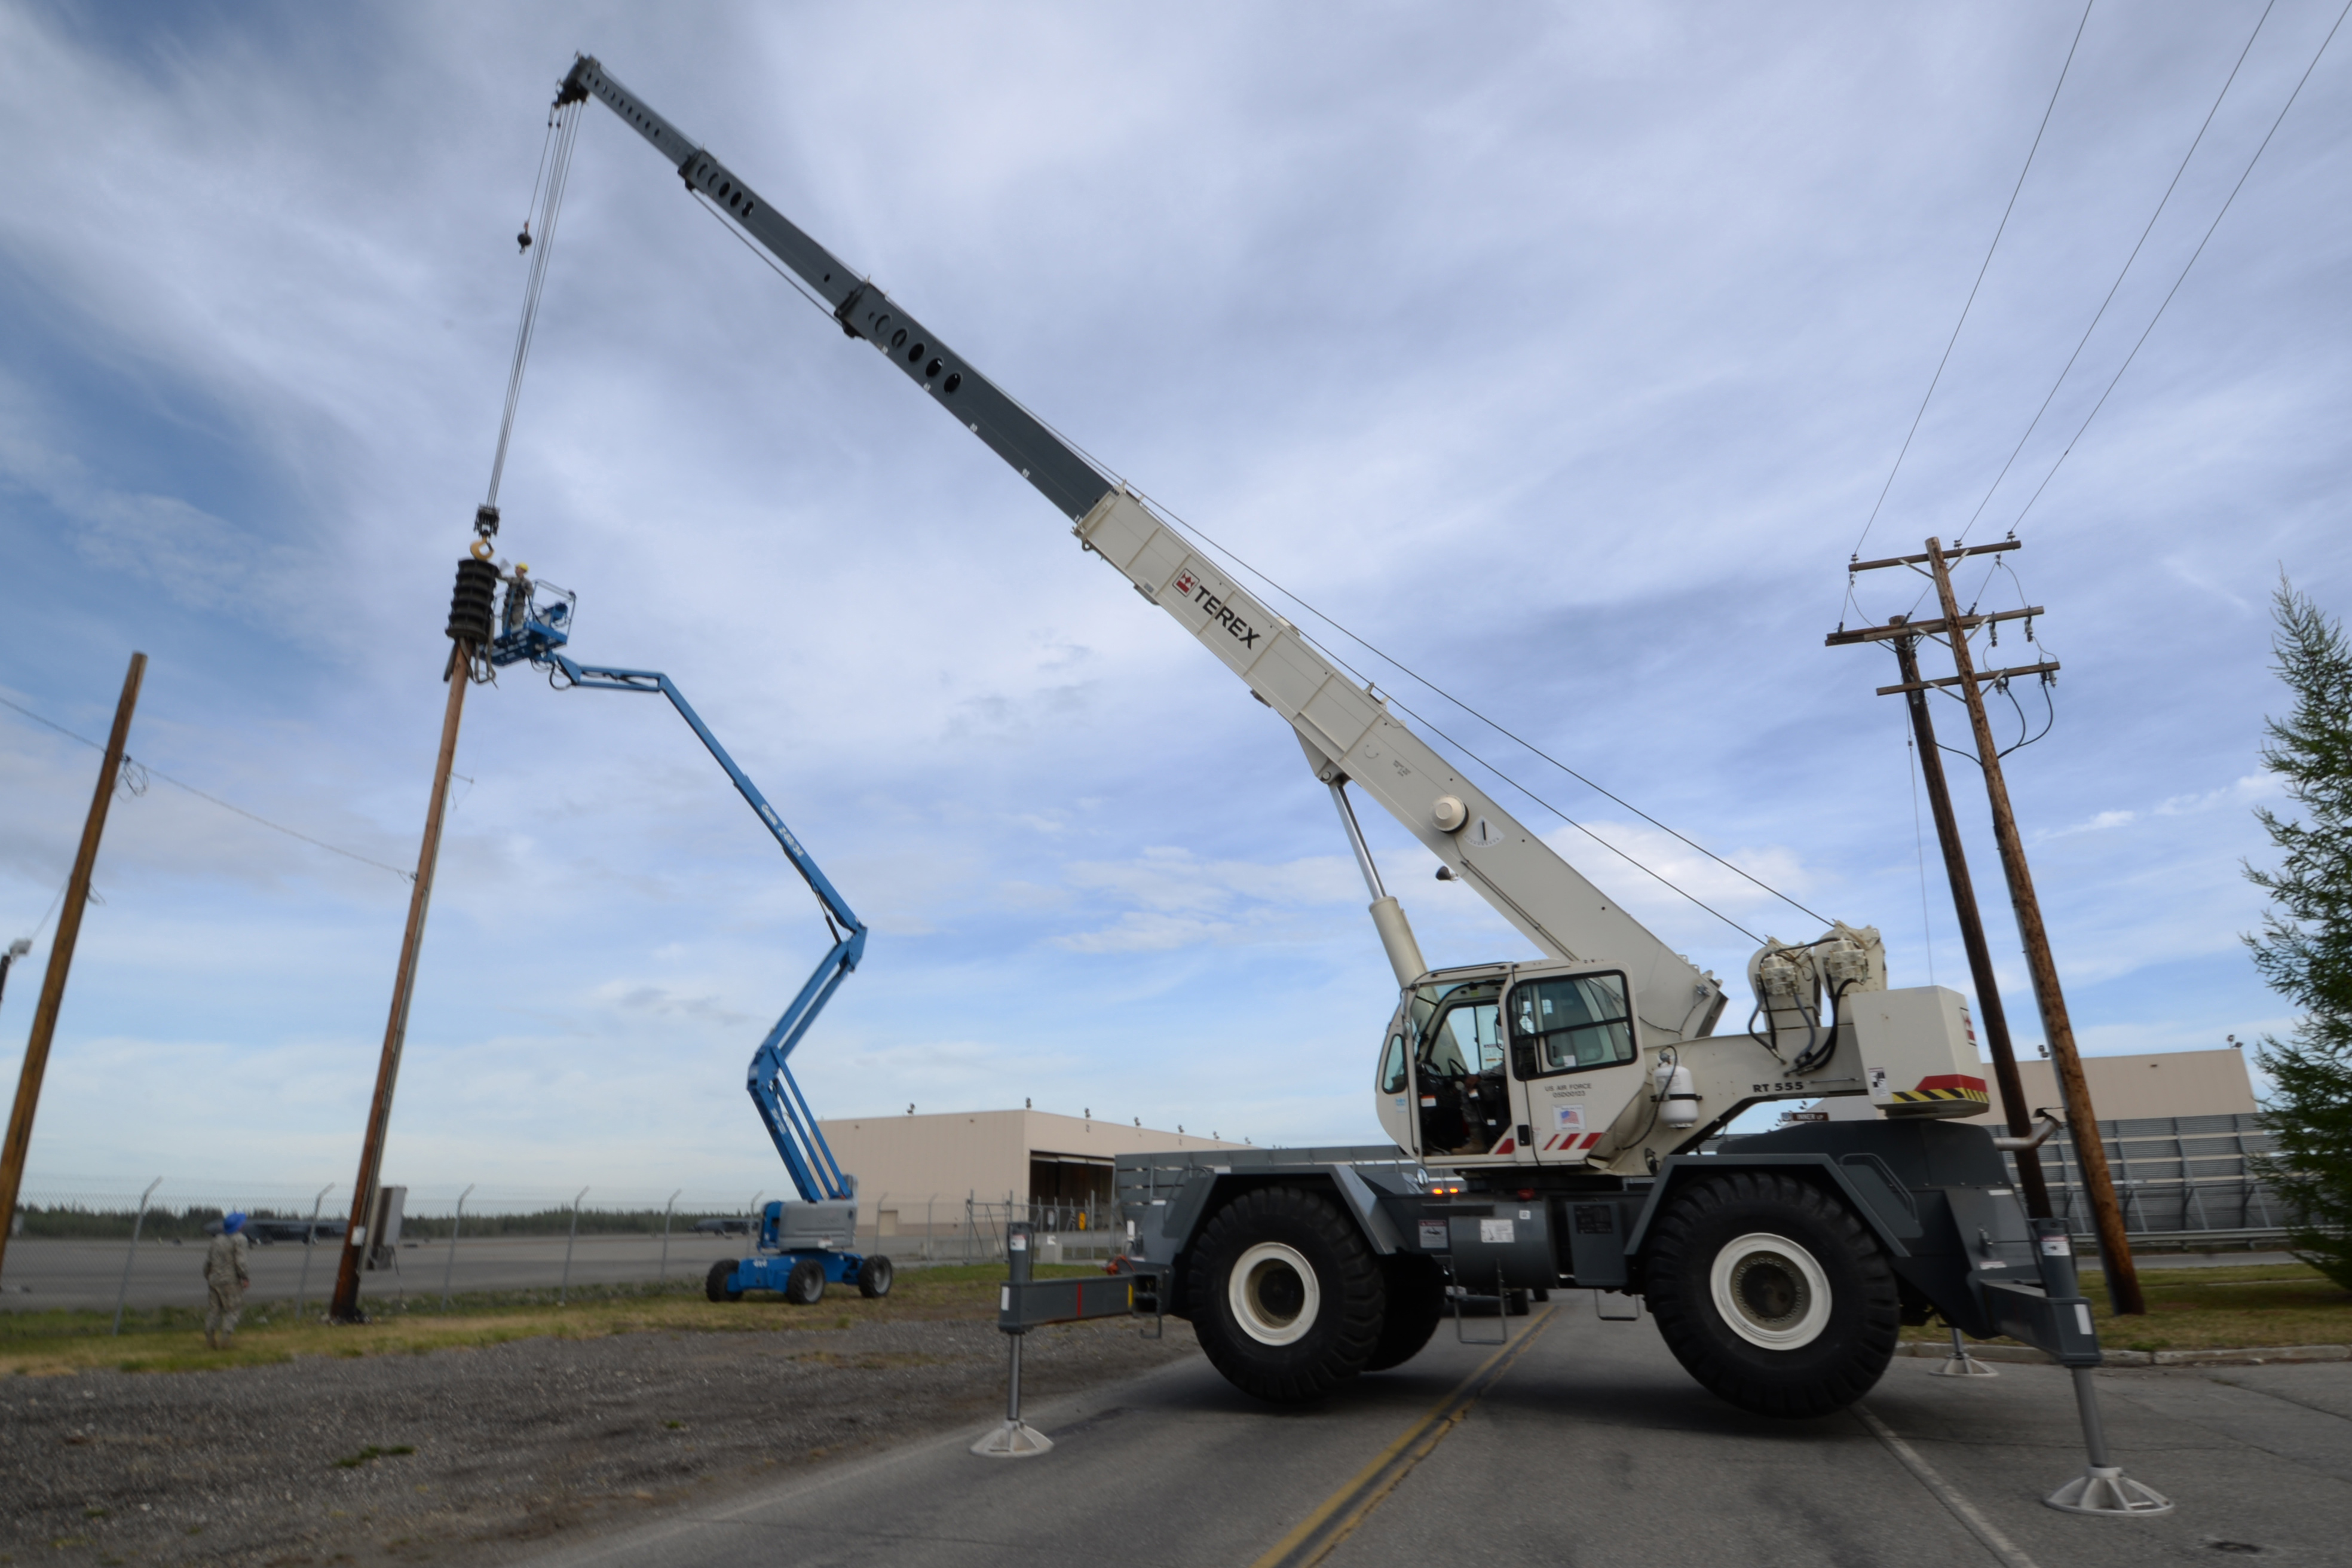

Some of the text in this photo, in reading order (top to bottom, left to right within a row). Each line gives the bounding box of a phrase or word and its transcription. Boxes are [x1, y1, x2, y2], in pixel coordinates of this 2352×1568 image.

[1195, 585, 1261, 650] TEREX
[1753, 1082, 1803, 1092] RT 555
